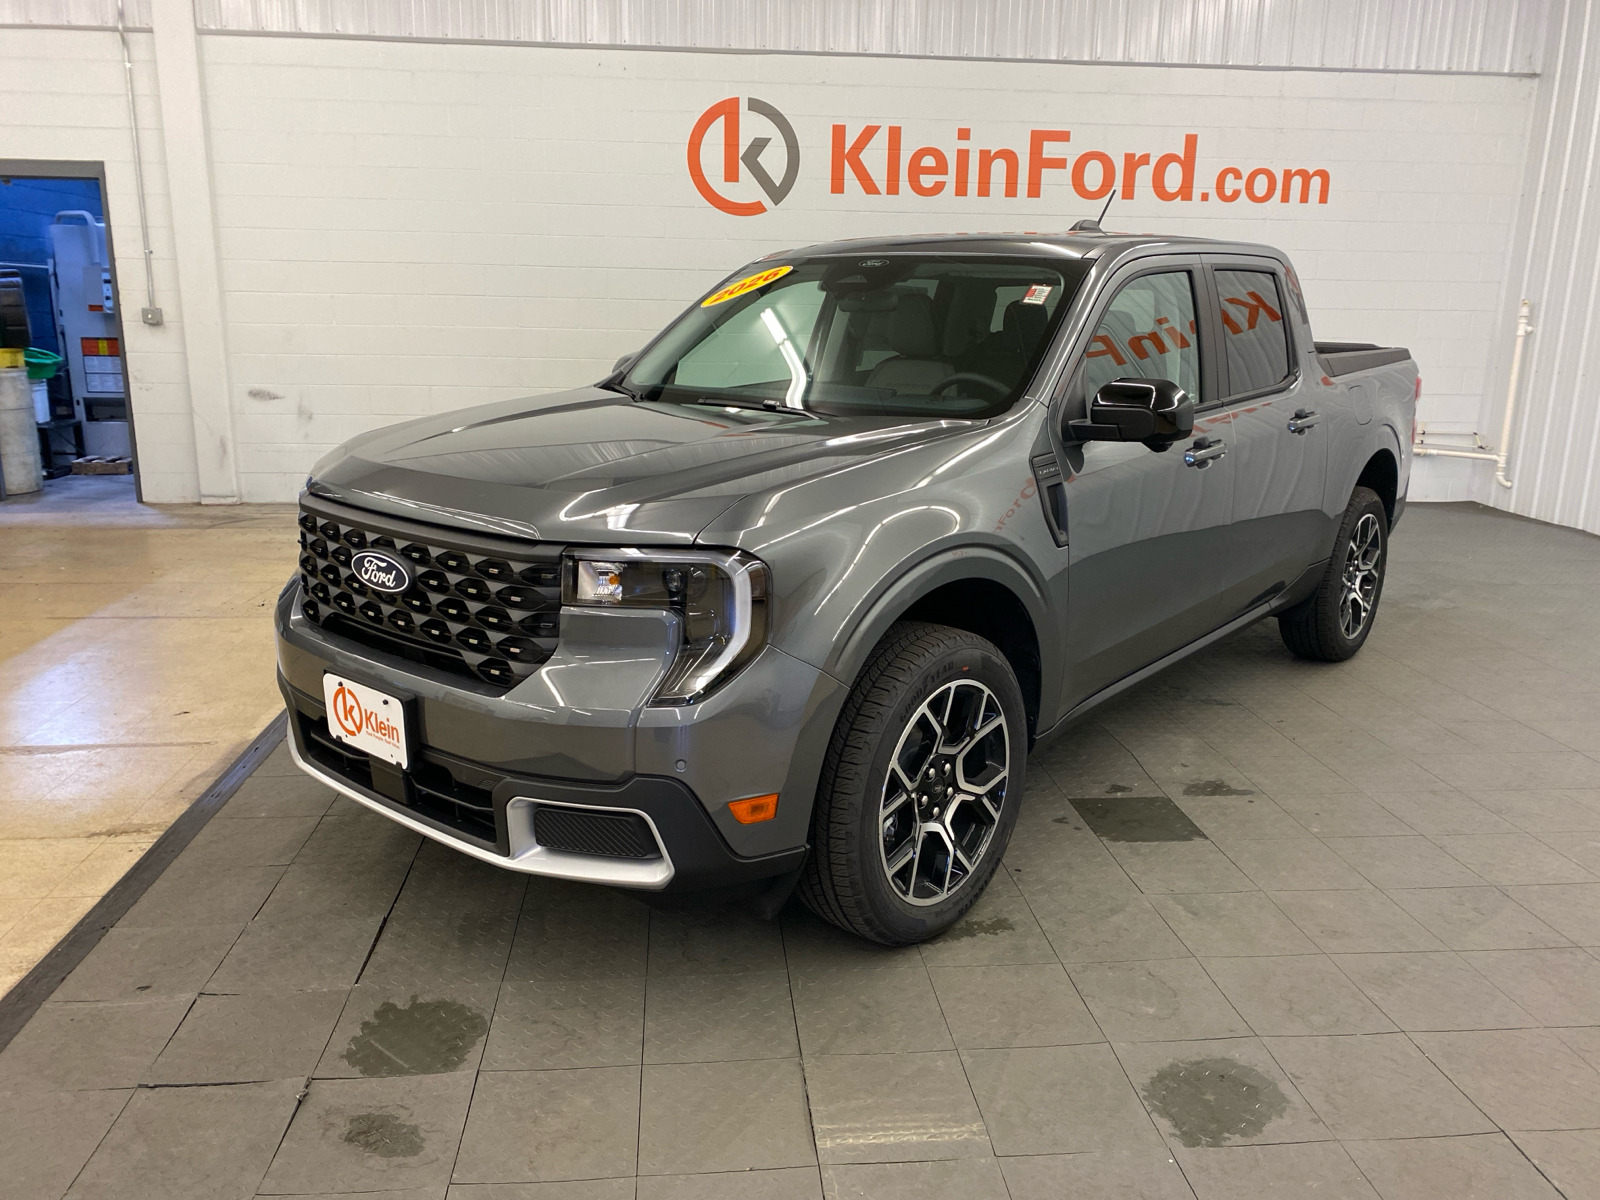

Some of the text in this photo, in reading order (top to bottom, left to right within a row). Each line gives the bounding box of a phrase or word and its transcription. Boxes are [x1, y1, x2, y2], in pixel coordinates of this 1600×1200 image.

[830, 124, 1331, 204] KleinFord.com
[709, 267, 783, 304] 2026
[361, 556, 396, 587] Ford
[900, 661, 954, 722] GOODYEAR
[364, 708, 400, 744] Klein
